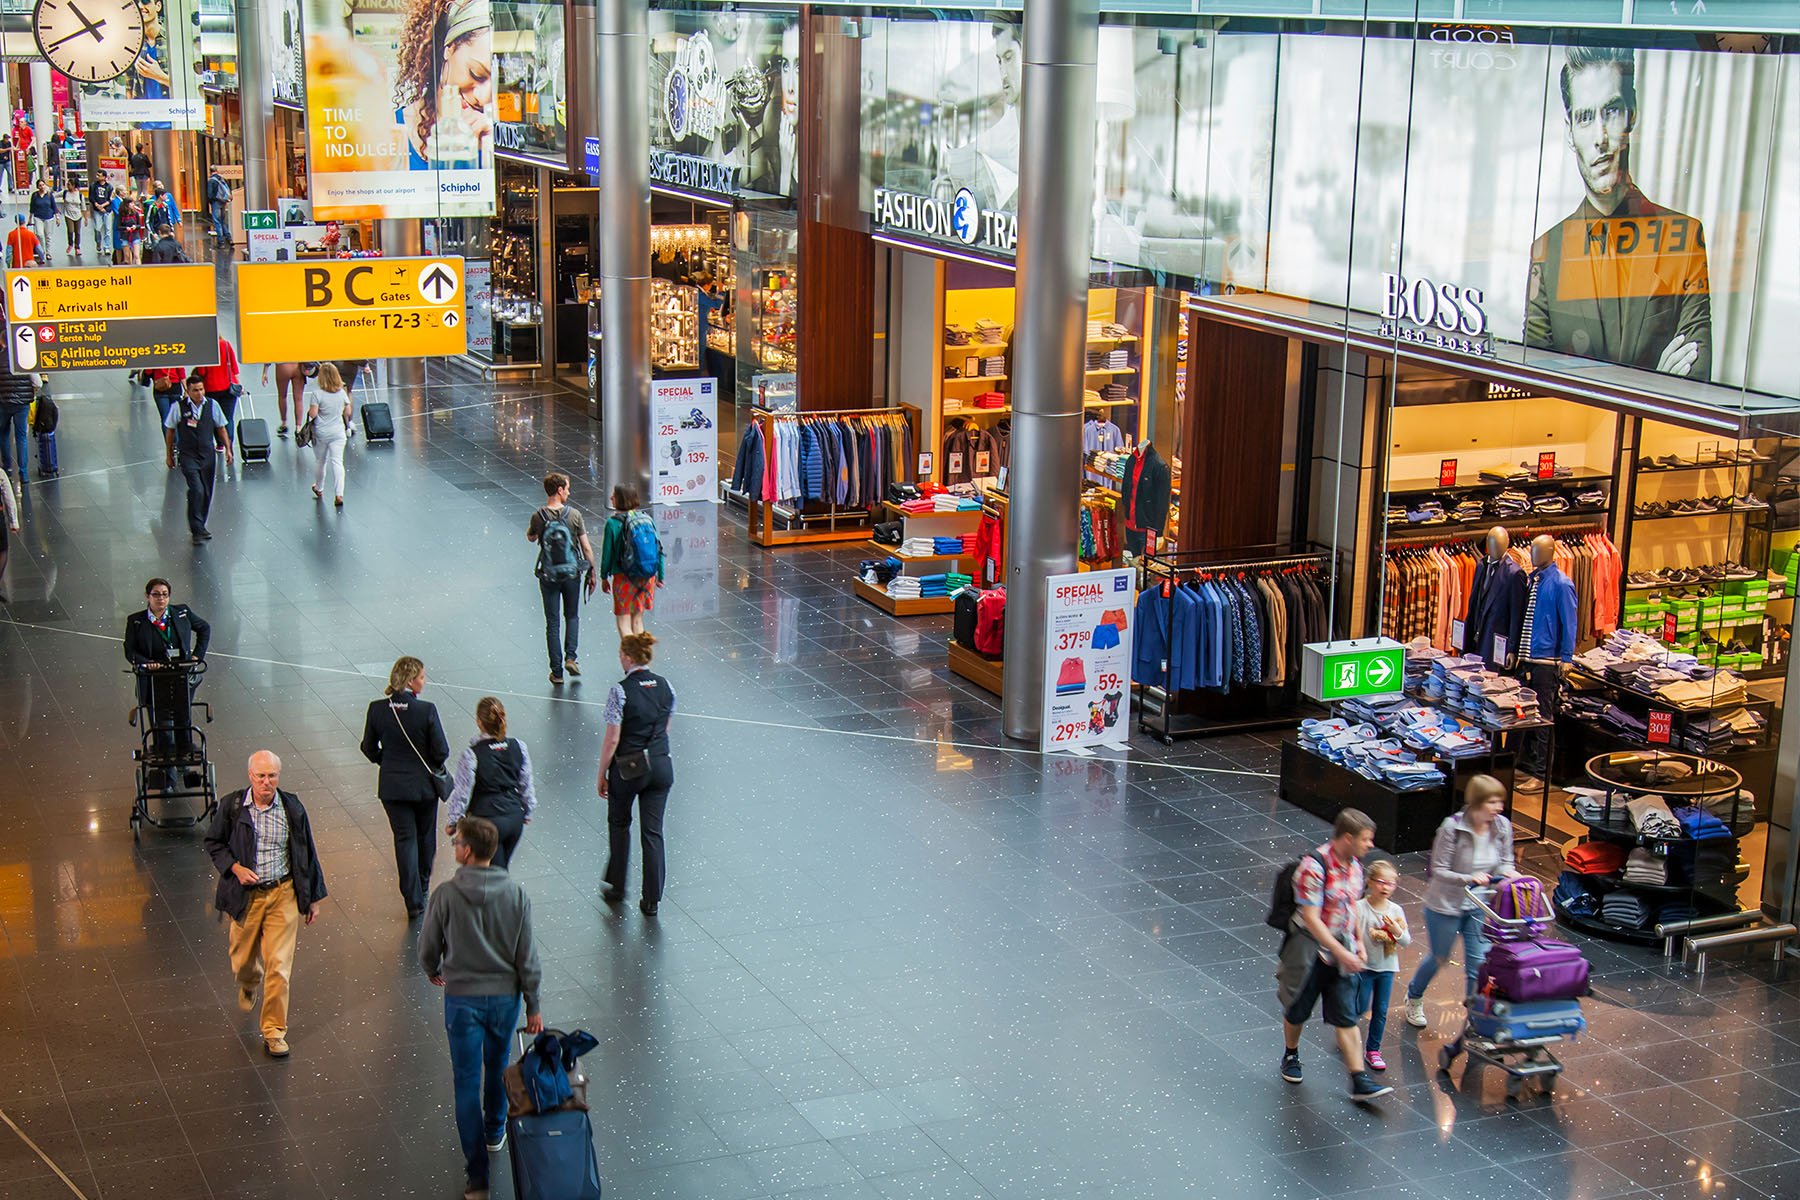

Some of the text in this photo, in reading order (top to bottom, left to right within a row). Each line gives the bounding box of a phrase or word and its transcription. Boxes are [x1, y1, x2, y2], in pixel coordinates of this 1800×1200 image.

[169, 107, 196, 115] Schiphol
[323, 108, 362, 122] TIME
[324, 126, 346, 140] TO
[325, 142, 412, 158] INDULGE...
[675, 155, 735, 195] JEWELRY
[327, 189, 344, 197] Enjoy
[357, 188, 375, 196] shops
[395, 187, 416, 196] airport
[440, 182, 481, 194] Schiphol
[874, 189, 950, 237] FASHION
[56, 276, 132, 290] Baggage hall
[304, 266, 411, 307] B C Gates
[57, 300, 128, 313] Arrivals hall
[1381, 272, 1485, 336] BOSS
[58, 321, 107, 334] First aid
[333, 312, 421, 329] Transfer T2-3
[59, 334, 102, 343] Eerste hulp
[1381, 324, 1484, 356] HUGO BOSS
[60, 343, 187, 359] Airline lounges 25-52
[61, 357, 127, 368] By invitation only
[657, 386, 694, 396] SPECIAL
[1056, 583, 1104, 599] SPECIAL
[1063, 594, 1104, 607] OFFERS
[1650, 711, 1671, 721] SALE
